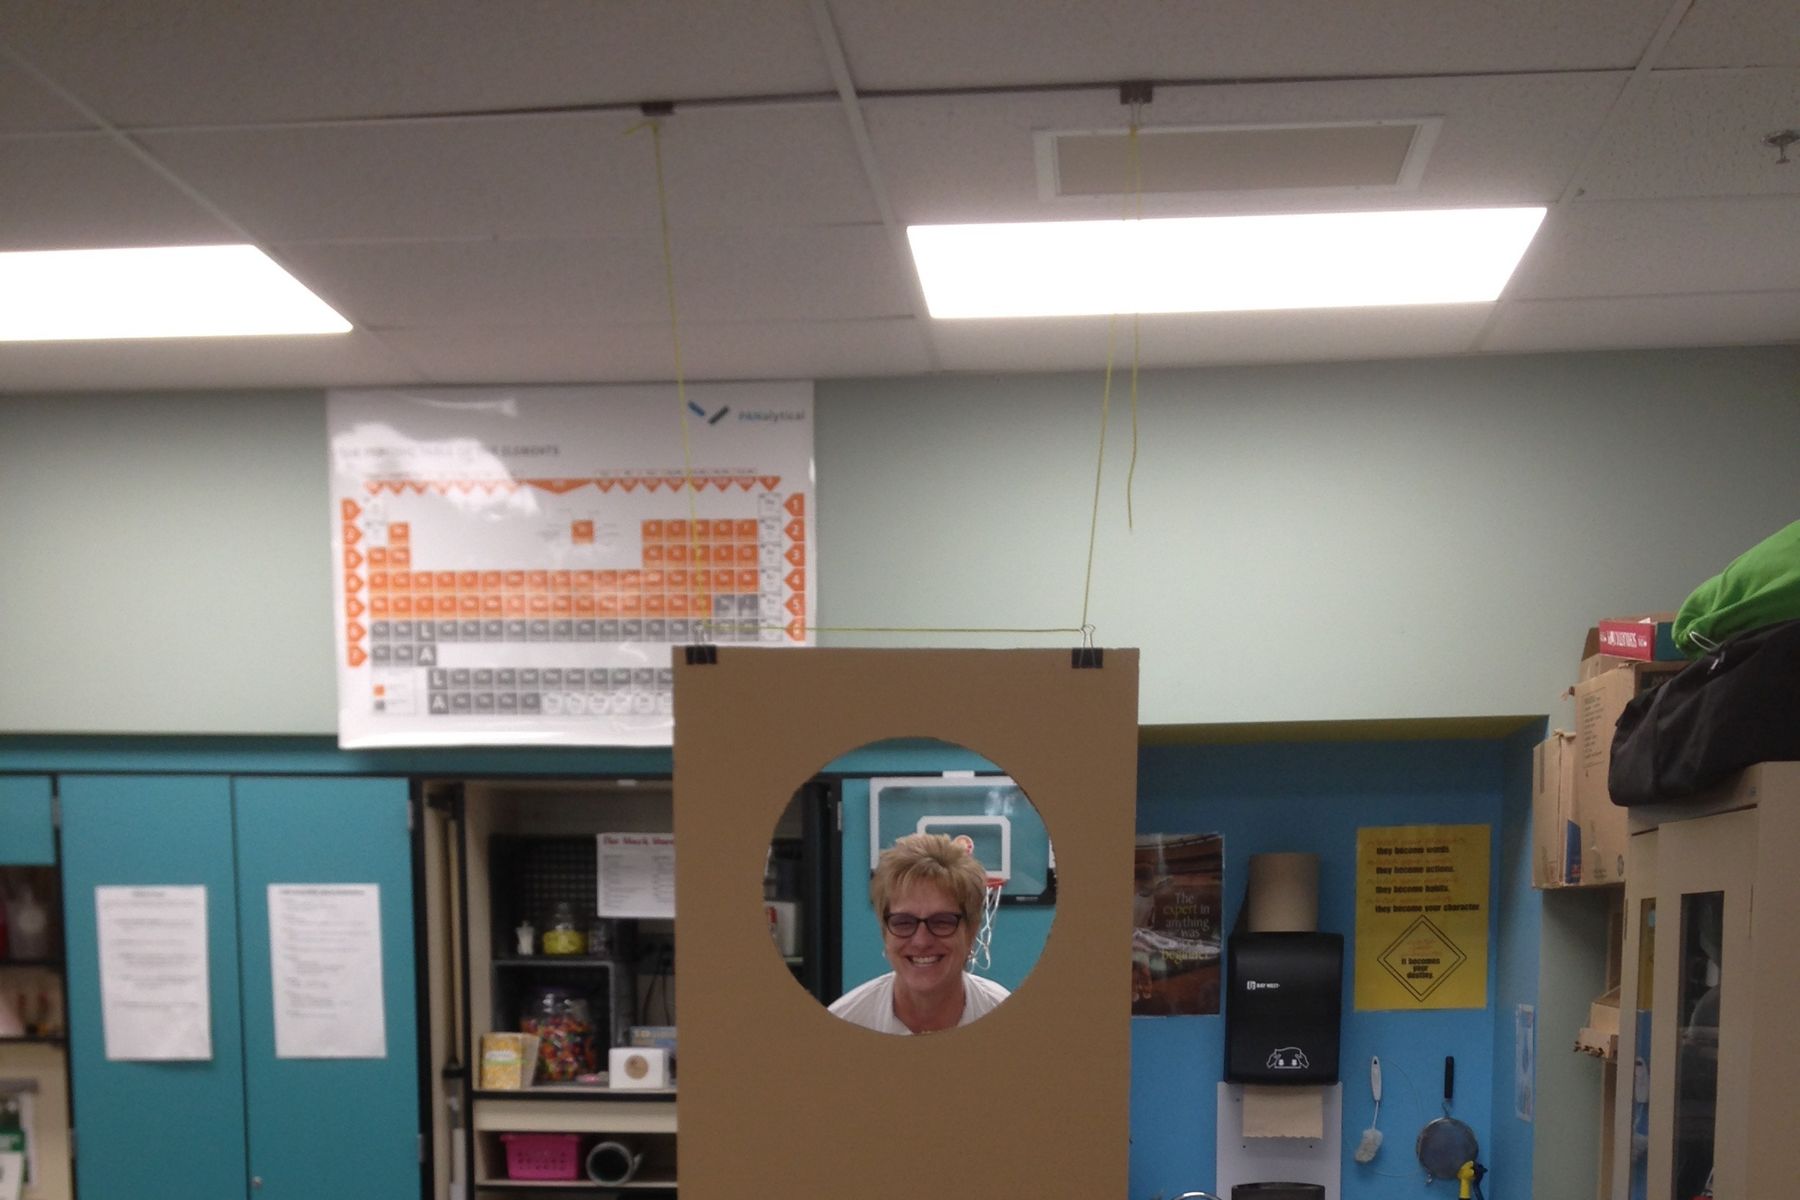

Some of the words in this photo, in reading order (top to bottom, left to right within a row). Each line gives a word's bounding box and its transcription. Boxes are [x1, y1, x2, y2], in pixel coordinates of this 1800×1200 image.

[421, 622, 431, 638] L
[420, 646, 434, 661] A
[432, 671, 443, 686] L
[432, 695, 447, 709] A
[1394, 847, 1424, 855] become
[1375, 886, 1392, 894] they
[1393, 885, 1423, 893] become
[1175, 891, 1195, 905] The
[1163, 904, 1198, 919] expert
[1200, 905, 1211, 914] in
[1375, 905, 1391, 913] they
[1393, 904, 1422, 912] become
[1424, 904, 1441, 912] your
[1166, 916, 1210, 931] anything
[1181, 930, 1200, 938] was
